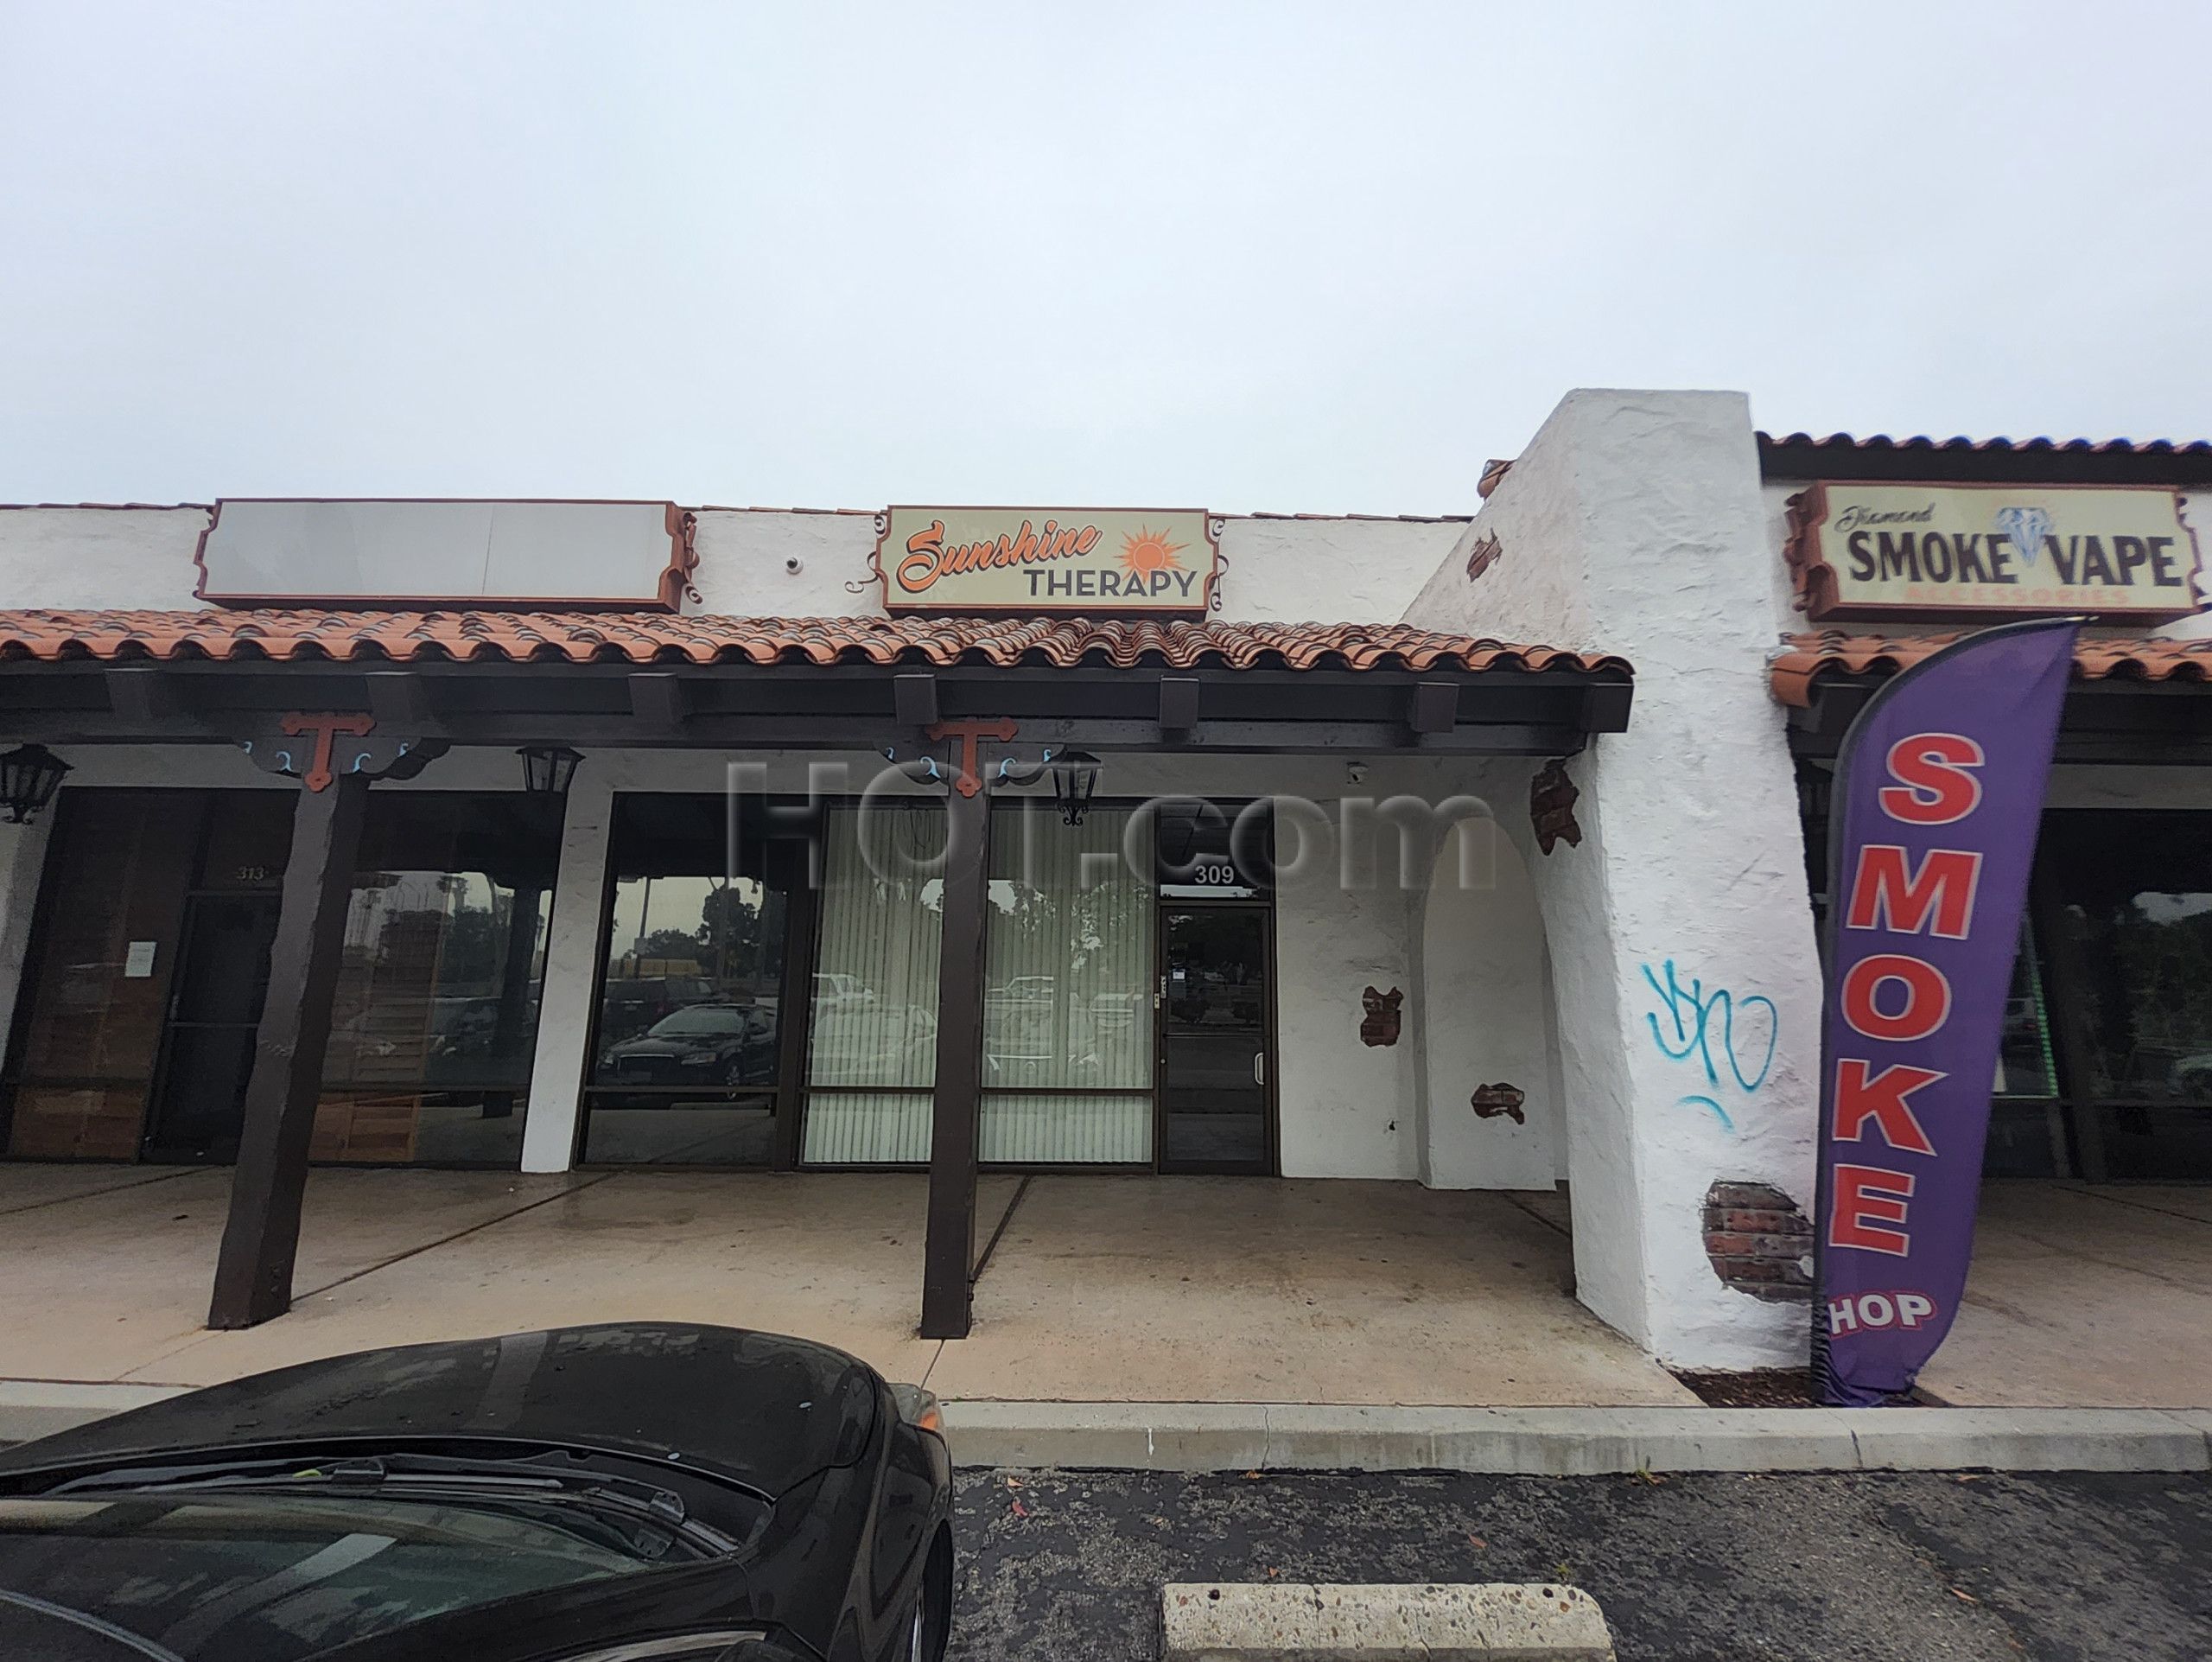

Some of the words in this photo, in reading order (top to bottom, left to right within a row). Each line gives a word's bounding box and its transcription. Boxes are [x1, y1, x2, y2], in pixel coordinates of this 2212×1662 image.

[896, 519, 1103, 594] Sunshine
[1023, 568, 1198, 597] THERAPY
[1847, 530, 2018, 584] SMOKE
[2044, 534, 2184, 587] VAPE
[1194, 865, 1235, 885] 309
[1828, 731, 1986, 1258] SMOKE
[1827, 1291, 1938, 1338] HOP
